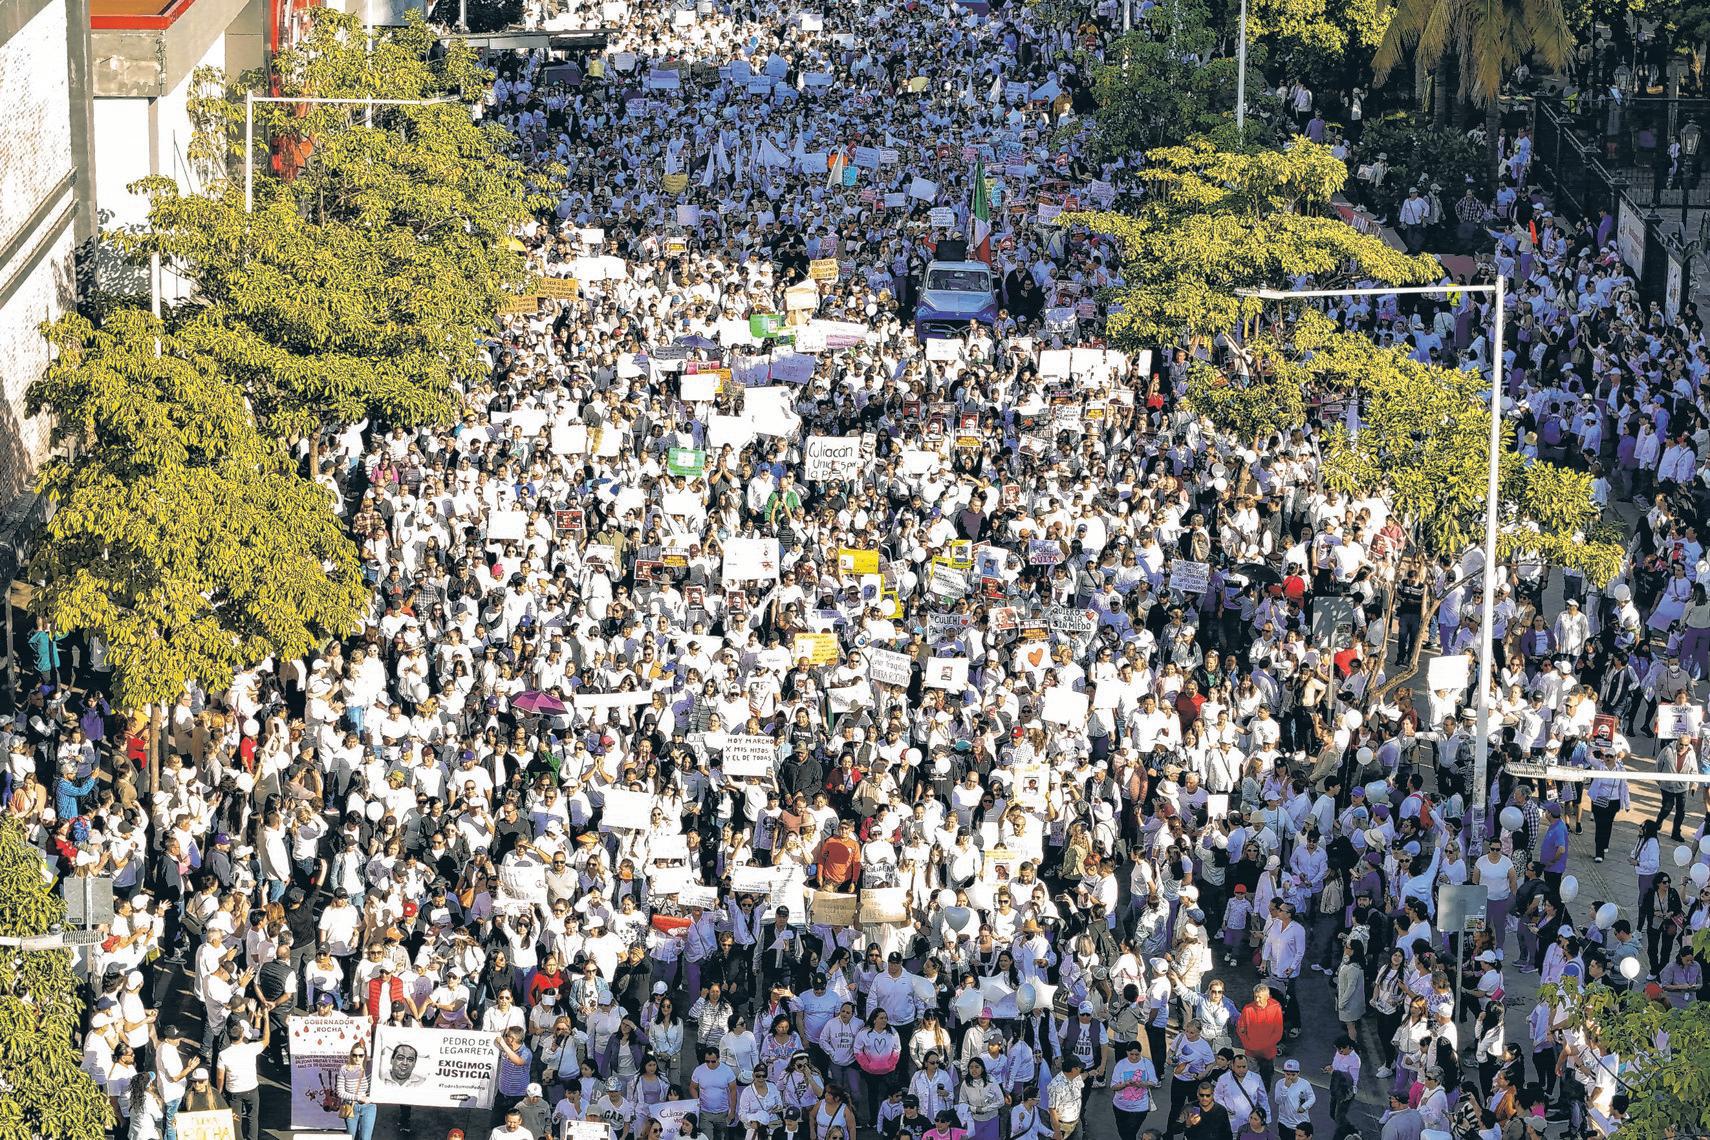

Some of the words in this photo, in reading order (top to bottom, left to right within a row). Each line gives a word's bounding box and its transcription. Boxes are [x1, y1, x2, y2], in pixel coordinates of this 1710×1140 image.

[1030, 556, 1059, 565] QUITA
[1052, 608, 1081, 617] QUIERO
[934, 615, 960, 624] CULICHI
[1063, 615, 1082, 623] SALIR
[1053, 620, 1068, 628] SIN
[1068, 622, 1091, 630] MIEDO
[442, 1036, 476, 1047] PEDRO
[478, 1038, 491, 1047] DE
[439, 1046, 495, 1056] LEGARRETA
[438, 1060, 492, 1070] EXIGIMOS
[435, 1068, 491, 1079] JUSTICIA
[605, 1110, 623, 1122] GAP
